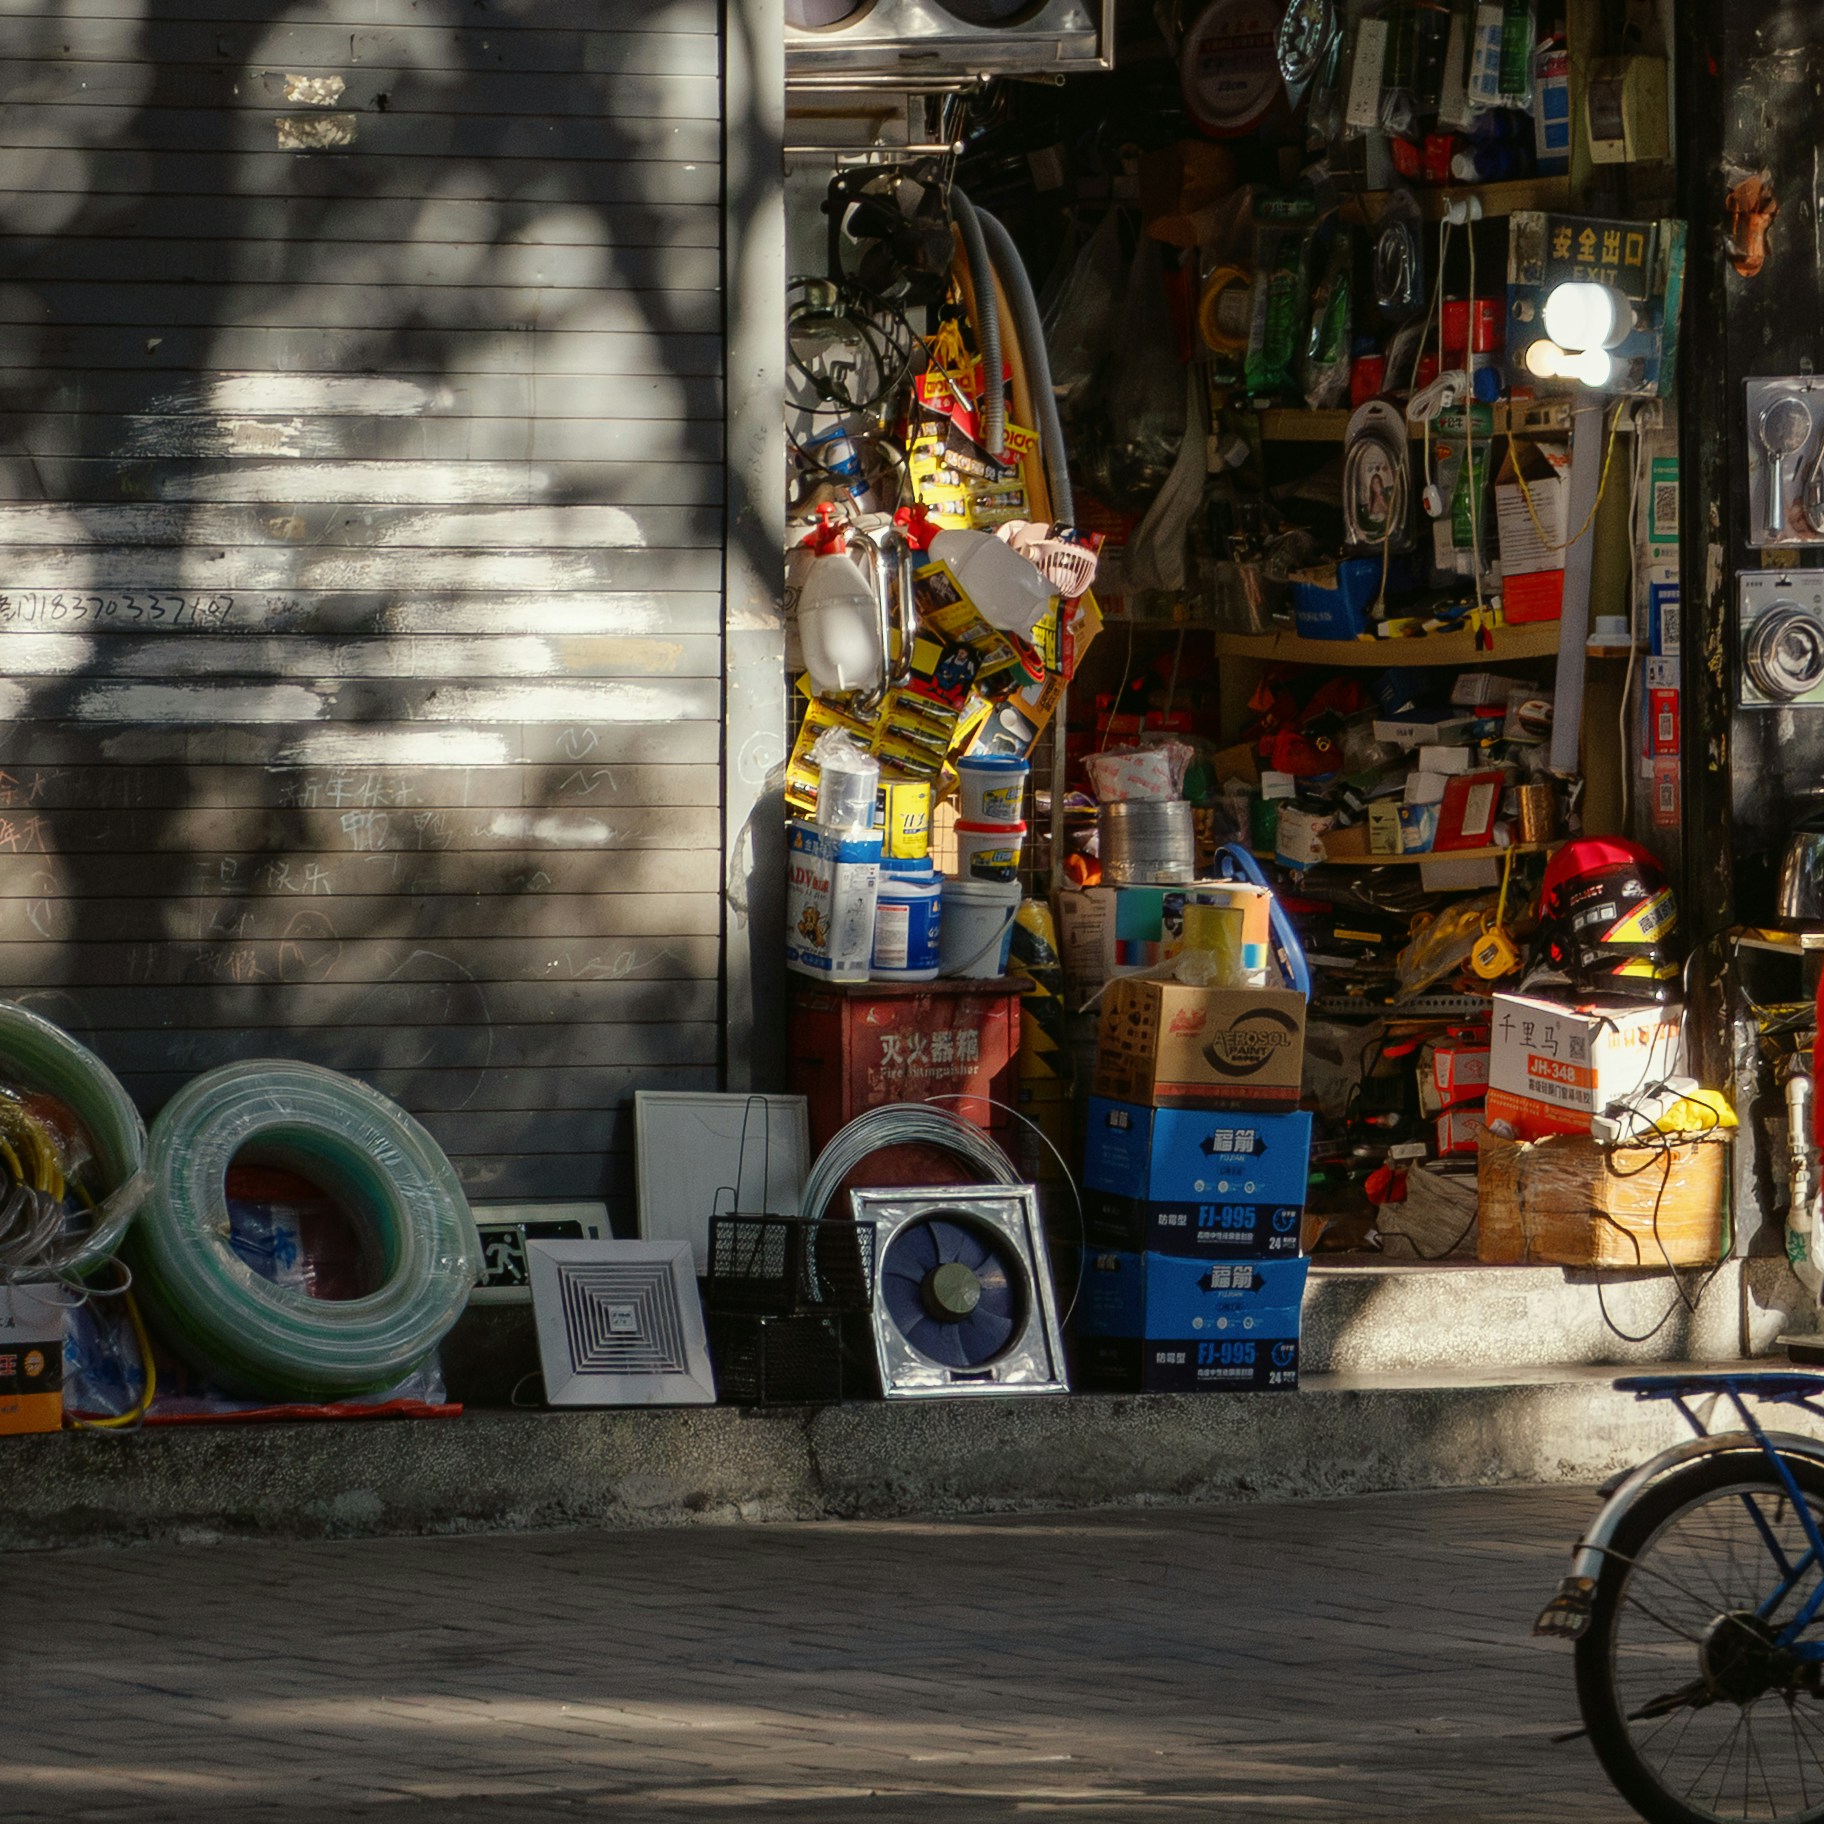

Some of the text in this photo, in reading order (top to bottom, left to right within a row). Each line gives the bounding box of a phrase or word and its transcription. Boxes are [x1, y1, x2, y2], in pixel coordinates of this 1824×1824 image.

[1551, 225, 1645, 268] 安全出口
[1572, 265, 1618, 286] EXIT
[879, 1028, 980, 1066] 灭火器箱
[1212, 1030, 1291, 1049] AEROSOL
[1498, 1013, 1559, 1057] 千里马
[1530, 1058, 1576, 1083] JH-348
[1196, 1205, 1257, 1230] FJ-995
[1196, 1342, 1257, 1366] FJ-995
